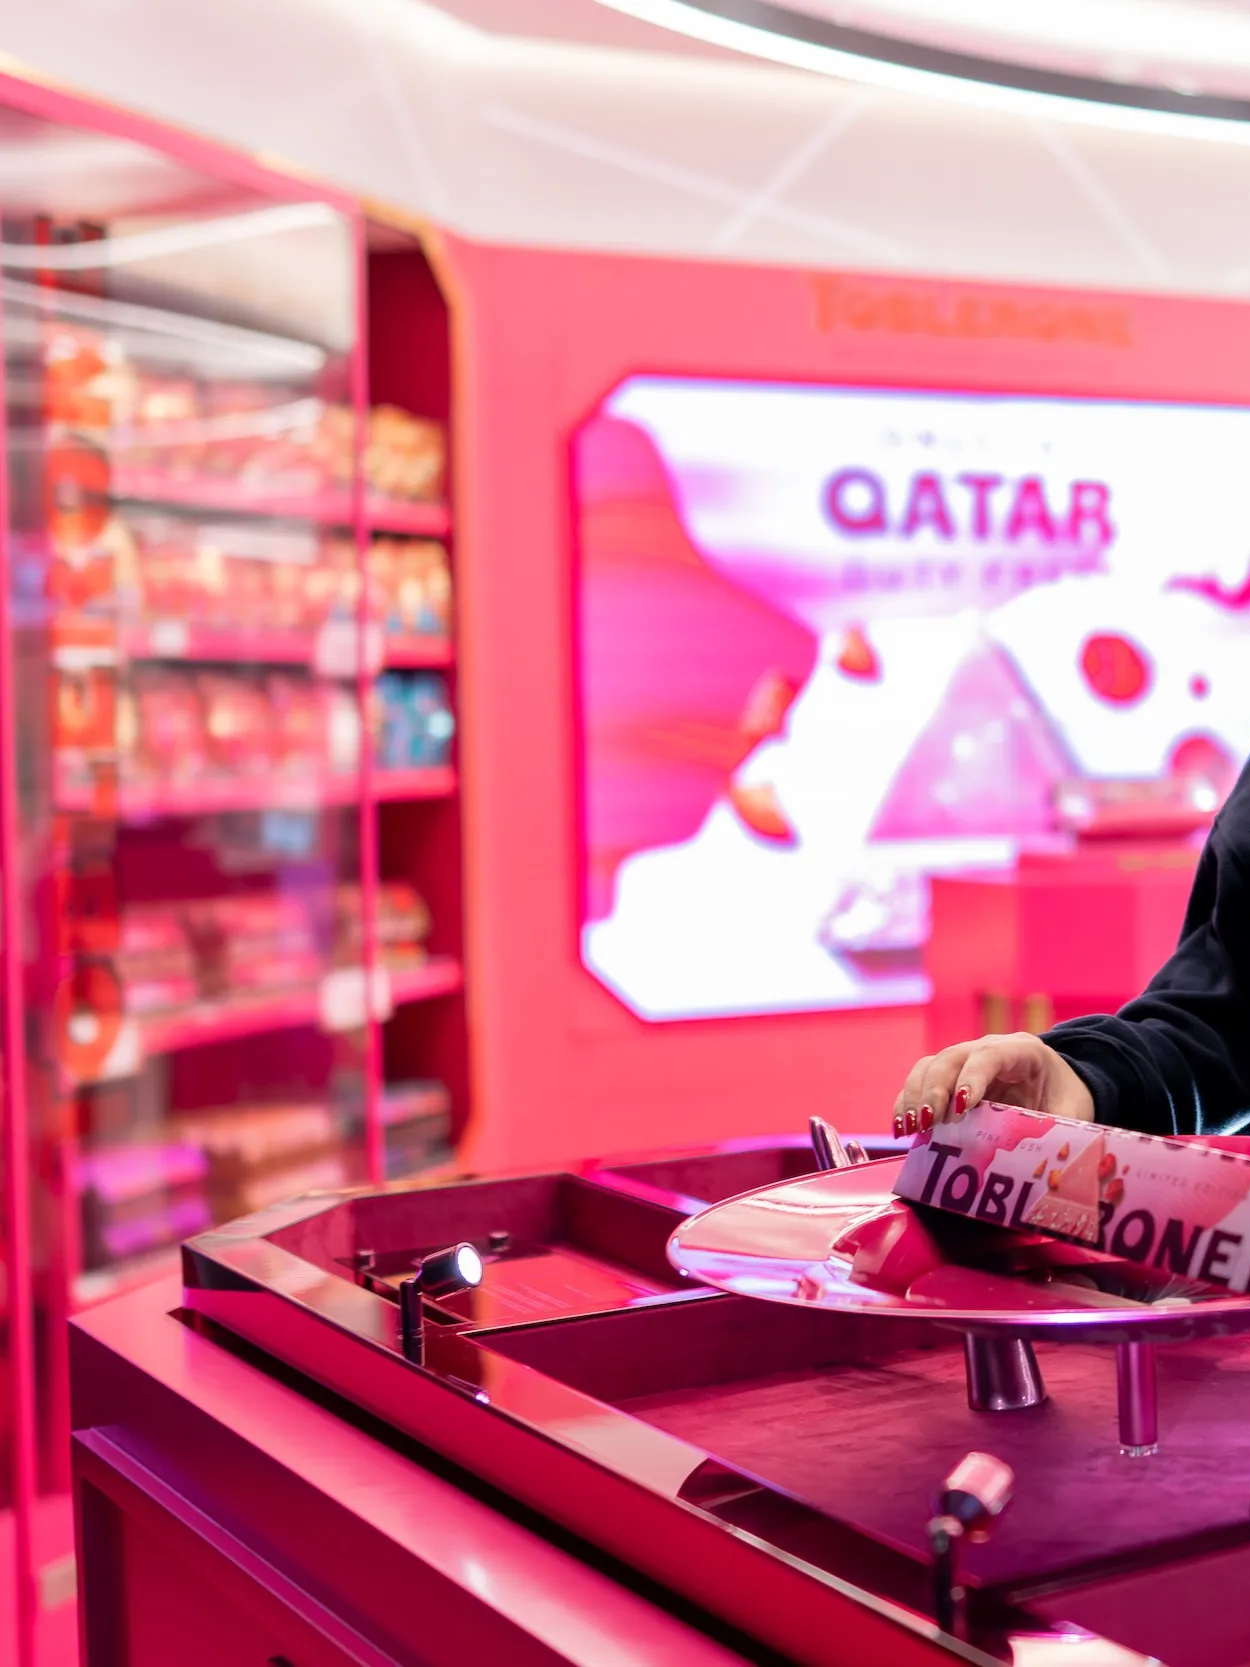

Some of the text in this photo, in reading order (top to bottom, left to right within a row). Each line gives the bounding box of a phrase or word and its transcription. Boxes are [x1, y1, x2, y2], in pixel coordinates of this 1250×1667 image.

[823, 465, 1118, 550] QATAR
[1005, 1136, 1043, 1153] CUSH
[920, 1142, 1243, 1286] TOBLRONE
